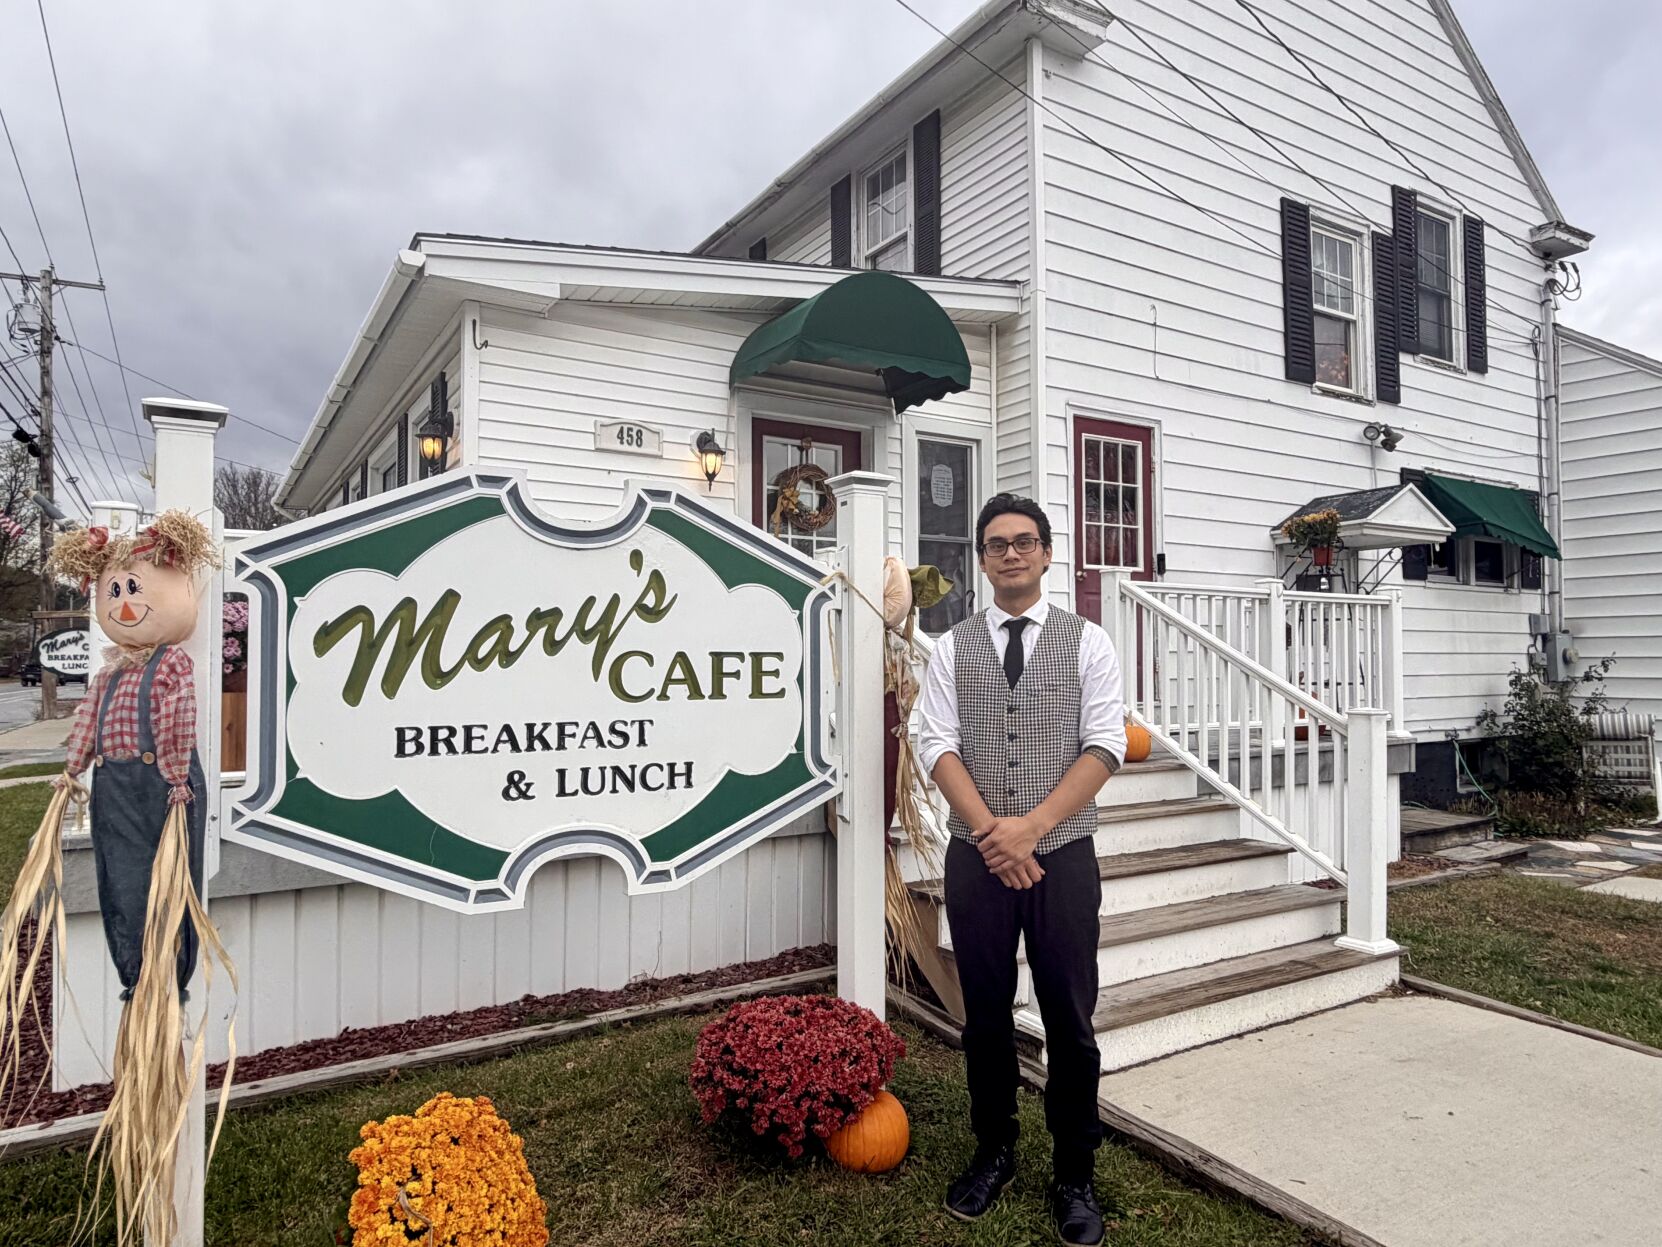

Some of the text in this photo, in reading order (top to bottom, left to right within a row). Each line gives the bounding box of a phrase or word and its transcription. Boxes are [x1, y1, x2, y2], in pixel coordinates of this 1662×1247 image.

[616, 425, 644, 448] 458
[41, 631, 85, 653] Mary's
[312, 547, 678, 708] Mary's
[607, 649, 787, 704] CAFE
[393, 718, 655, 760] BREAKFAST
[500, 761, 695, 802] & LUNCH
